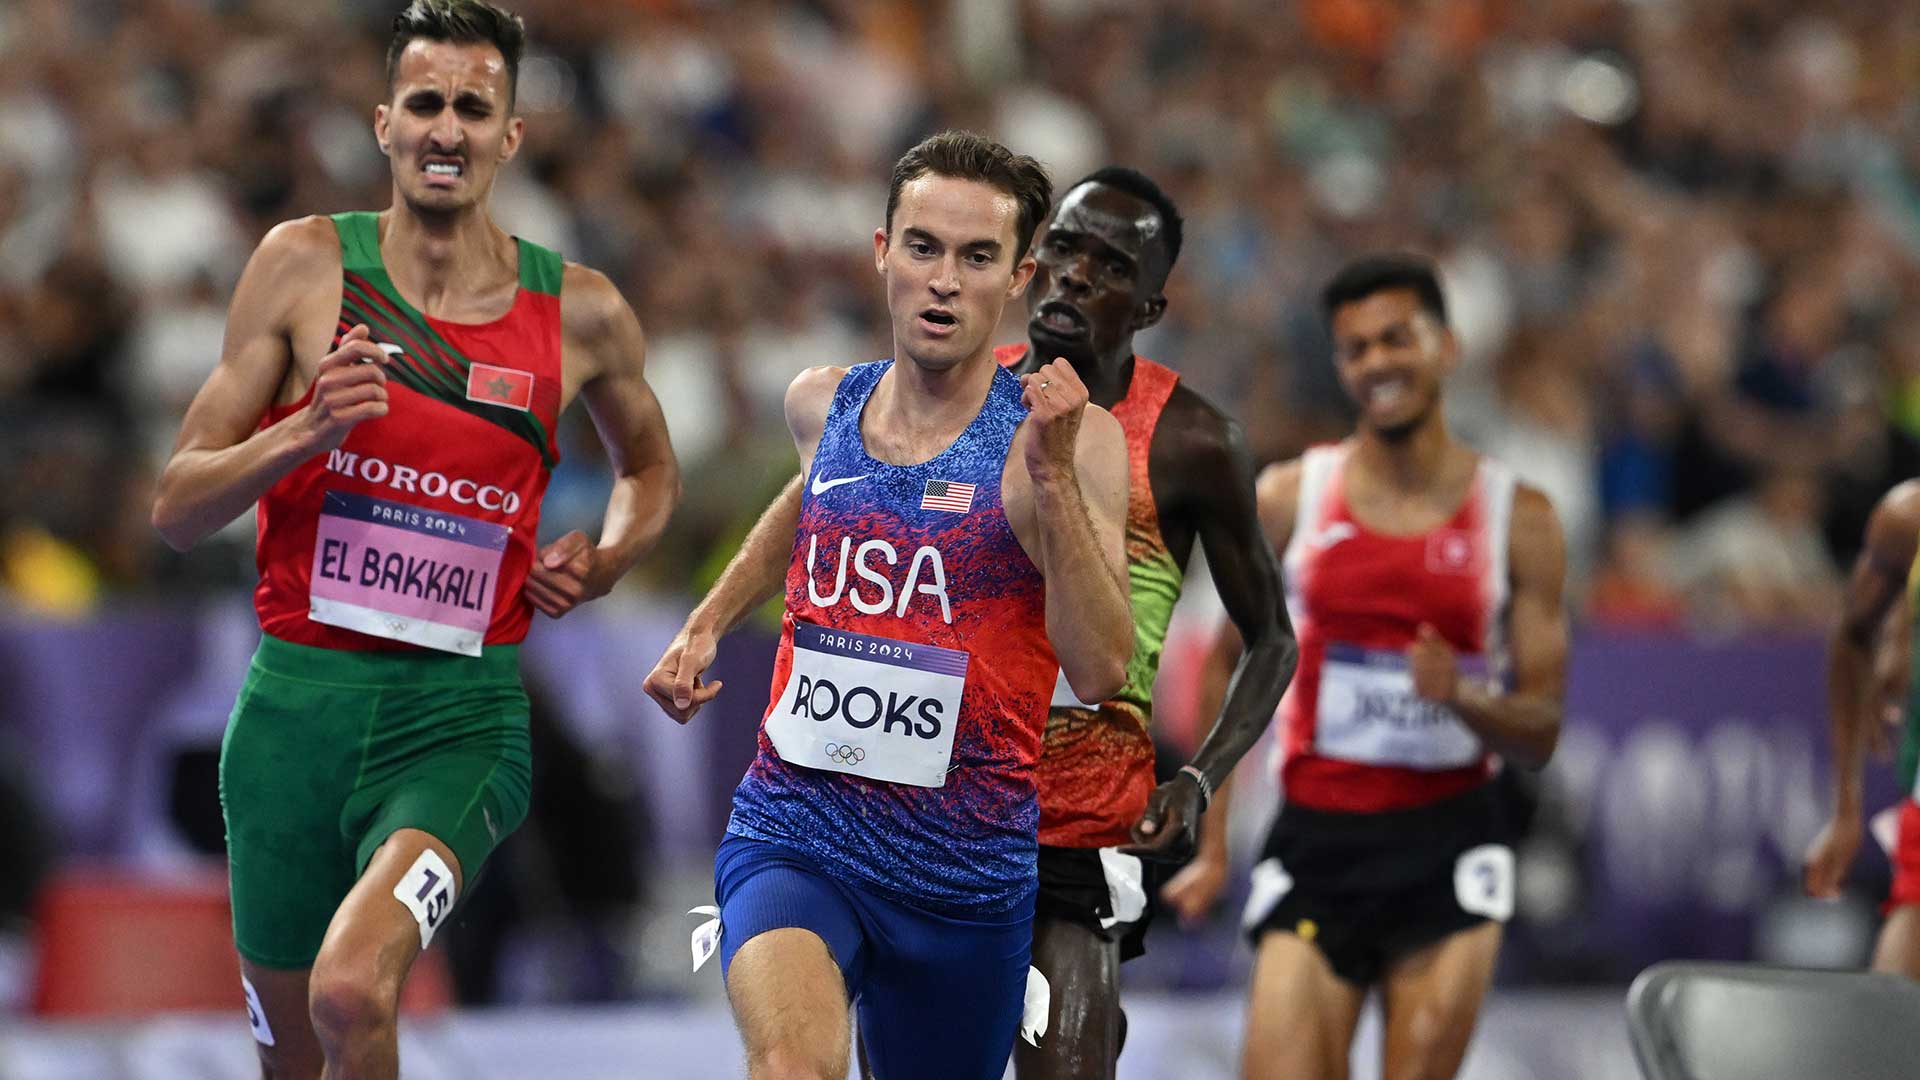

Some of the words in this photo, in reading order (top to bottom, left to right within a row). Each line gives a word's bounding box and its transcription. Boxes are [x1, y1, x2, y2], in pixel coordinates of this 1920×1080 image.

[325, 448, 520, 514] MOROCCO
[372, 505, 420, 526] PARIS
[425, 516, 466, 536] 2024
[320, 538, 351, 583] EL
[359, 547, 488, 611] BAKKALI
[806, 534, 952, 624] USA
[819, 633, 863, 652] PARIS
[868, 642, 912, 661] 2024
[791, 674, 944, 740] ROOKS
[415, 867, 448, 928] 15
